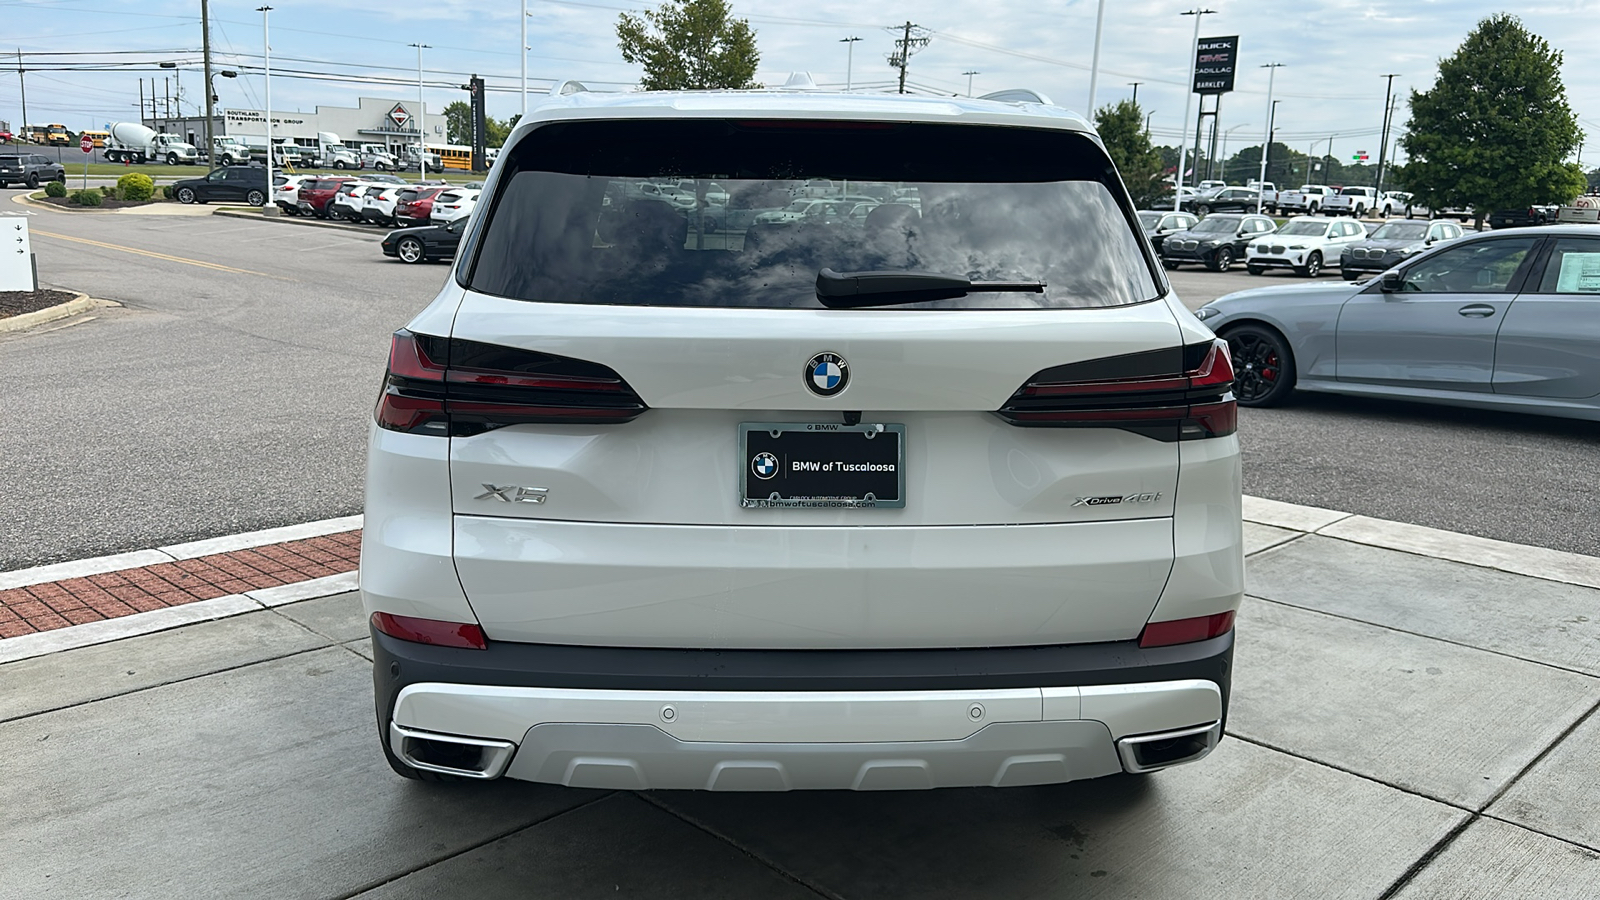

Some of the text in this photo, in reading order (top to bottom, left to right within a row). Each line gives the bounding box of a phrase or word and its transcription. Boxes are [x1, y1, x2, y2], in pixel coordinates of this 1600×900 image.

[1198, 42, 1232, 50] BUICK
[1199, 53, 1229, 62] GMC
[1196, 81, 1225, 89] BARKLEY
[81, 140, 93, 148] STOP
[810, 354, 847, 369] BMW
[792, 462, 895, 472] BMW of Tuscaloosa
[473, 483, 550, 505] X5
[770, 499, 876, 508] bmwoftuscaloosa.com
